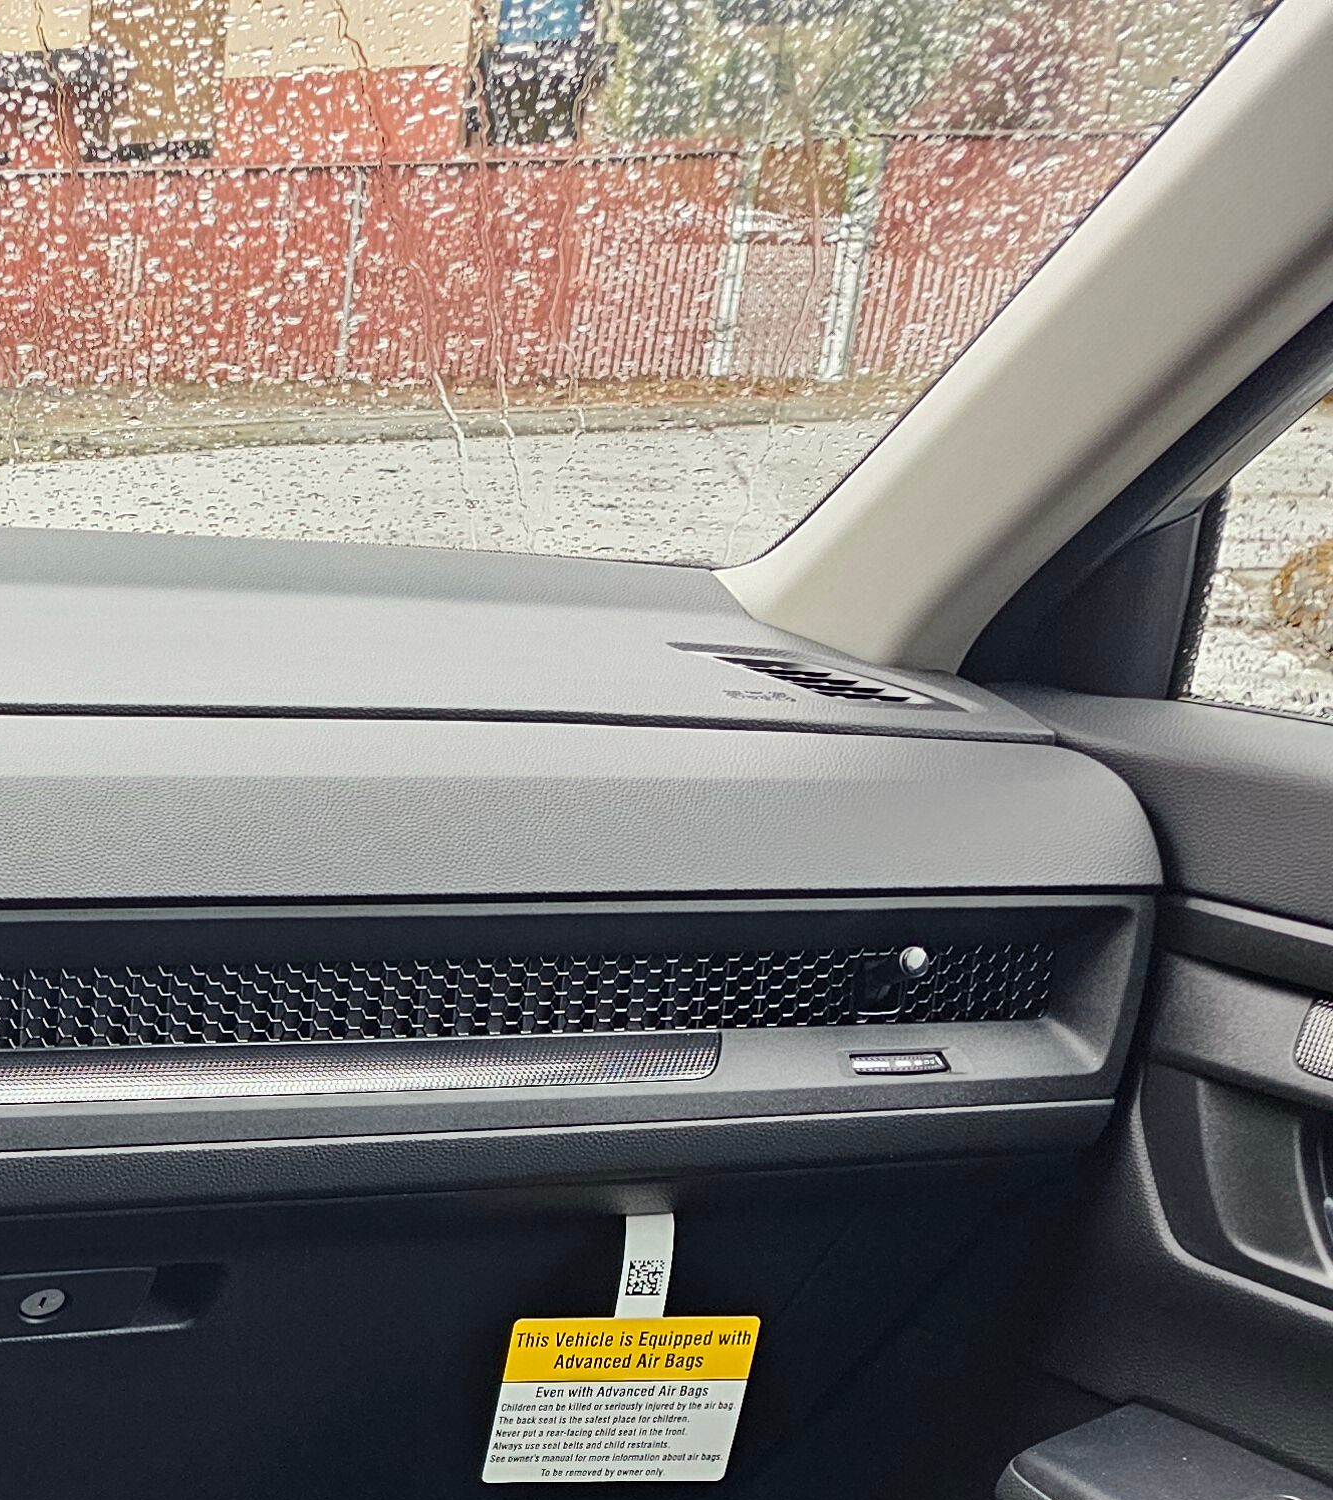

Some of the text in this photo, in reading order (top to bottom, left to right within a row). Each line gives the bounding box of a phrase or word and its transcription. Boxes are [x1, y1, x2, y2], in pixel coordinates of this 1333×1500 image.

[516, 1330, 752, 1349] This Vehicle is Equipped with
[553, 1353, 705, 1371] Advanced Air Bags
[535, 1385, 709, 1399] Even with Advanced Air Bags
[501, 1403, 536, 1412] Children
[555, 1403, 566, 1411] be
[568, 1403, 592, 1411] killed
[604, 1402, 642, 1412] seriously
[645, 1402, 674, 1412] injured
[677, 1402, 687, 1412] by
[688, 1402, 701, 1410] the
[704, 1402, 716, 1410] air
[718, 1402, 736, 1411] bag.
[499, 1415, 690, 1425] The back seat is the safest place for children.
[495, 1429, 520, 1437] Never
[522, 1429, 537, 1439] put
[546, 1429, 593, 1438] rear-facing
[594, 1428, 616, 1437] child
[617, 1428, 636, 1436] seat
[638, 1428, 647, 1436] in
[649, 1428, 663, 1436] the
[493, 1442, 523, 1451] Always
[543, 1442, 561, 1450] seat
[563, 1441, 584, 1450] belts
[586, 1441, 602, 1449] and
[604, 1441, 625, 1449] child
[489, 1454, 505, 1463] See
[507, 1454, 540, 1463] owner's
[541, 1454, 573, 1462] manual
[574, 1454, 587, 1462] for
[612, 1453, 660, 1462] information
[662, 1453, 686, 1461] about
[687, 1453, 700, 1461] air
[541, 1468, 550, 1477] To
[552, 1468, 563, 1477] be
[565, 1468, 603, 1477] removed
[604, 1468, 615, 1478] by
